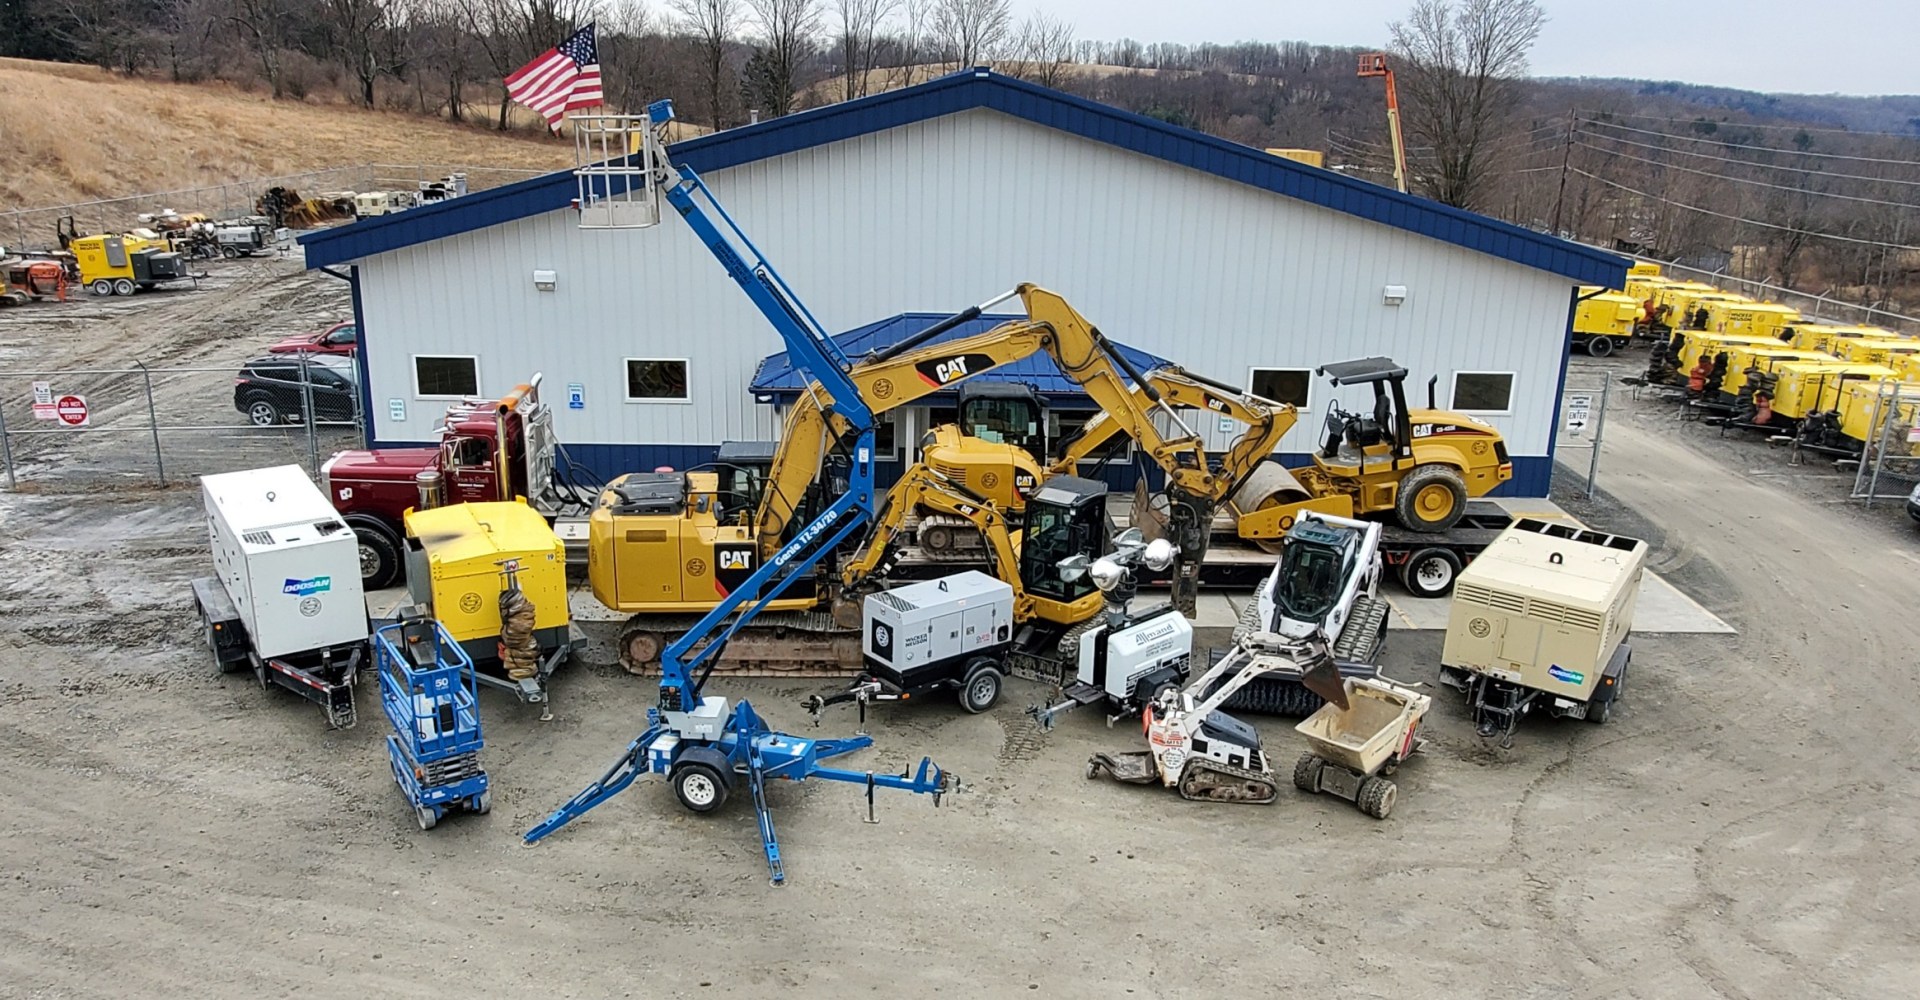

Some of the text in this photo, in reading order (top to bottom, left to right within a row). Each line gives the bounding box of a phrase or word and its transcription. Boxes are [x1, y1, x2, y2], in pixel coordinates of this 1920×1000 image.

[936, 356, 968, 383] CAT
[1209, 399, 1225, 411] CAT
[1569, 411, 1588, 420] ENTER
[1413, 424, 1433, 438] CAT
[1016, 475, 1034, 487] CAT
[960, 504, 974, 516] CAT
[775, 510, 838, 566] Genie TZ-34/20
[720, 551, 752, 569] CAT
[284, 579, 330, 593] DOOSAN
[905, 633, 928, 643] WACKER
[1135, 622, 1175, 646] Allmand
[905, 639, 928, 648] NEUSON
[1549, 668, 1583, 681] DOOSAN
[435, 677, 449, 688] 50
